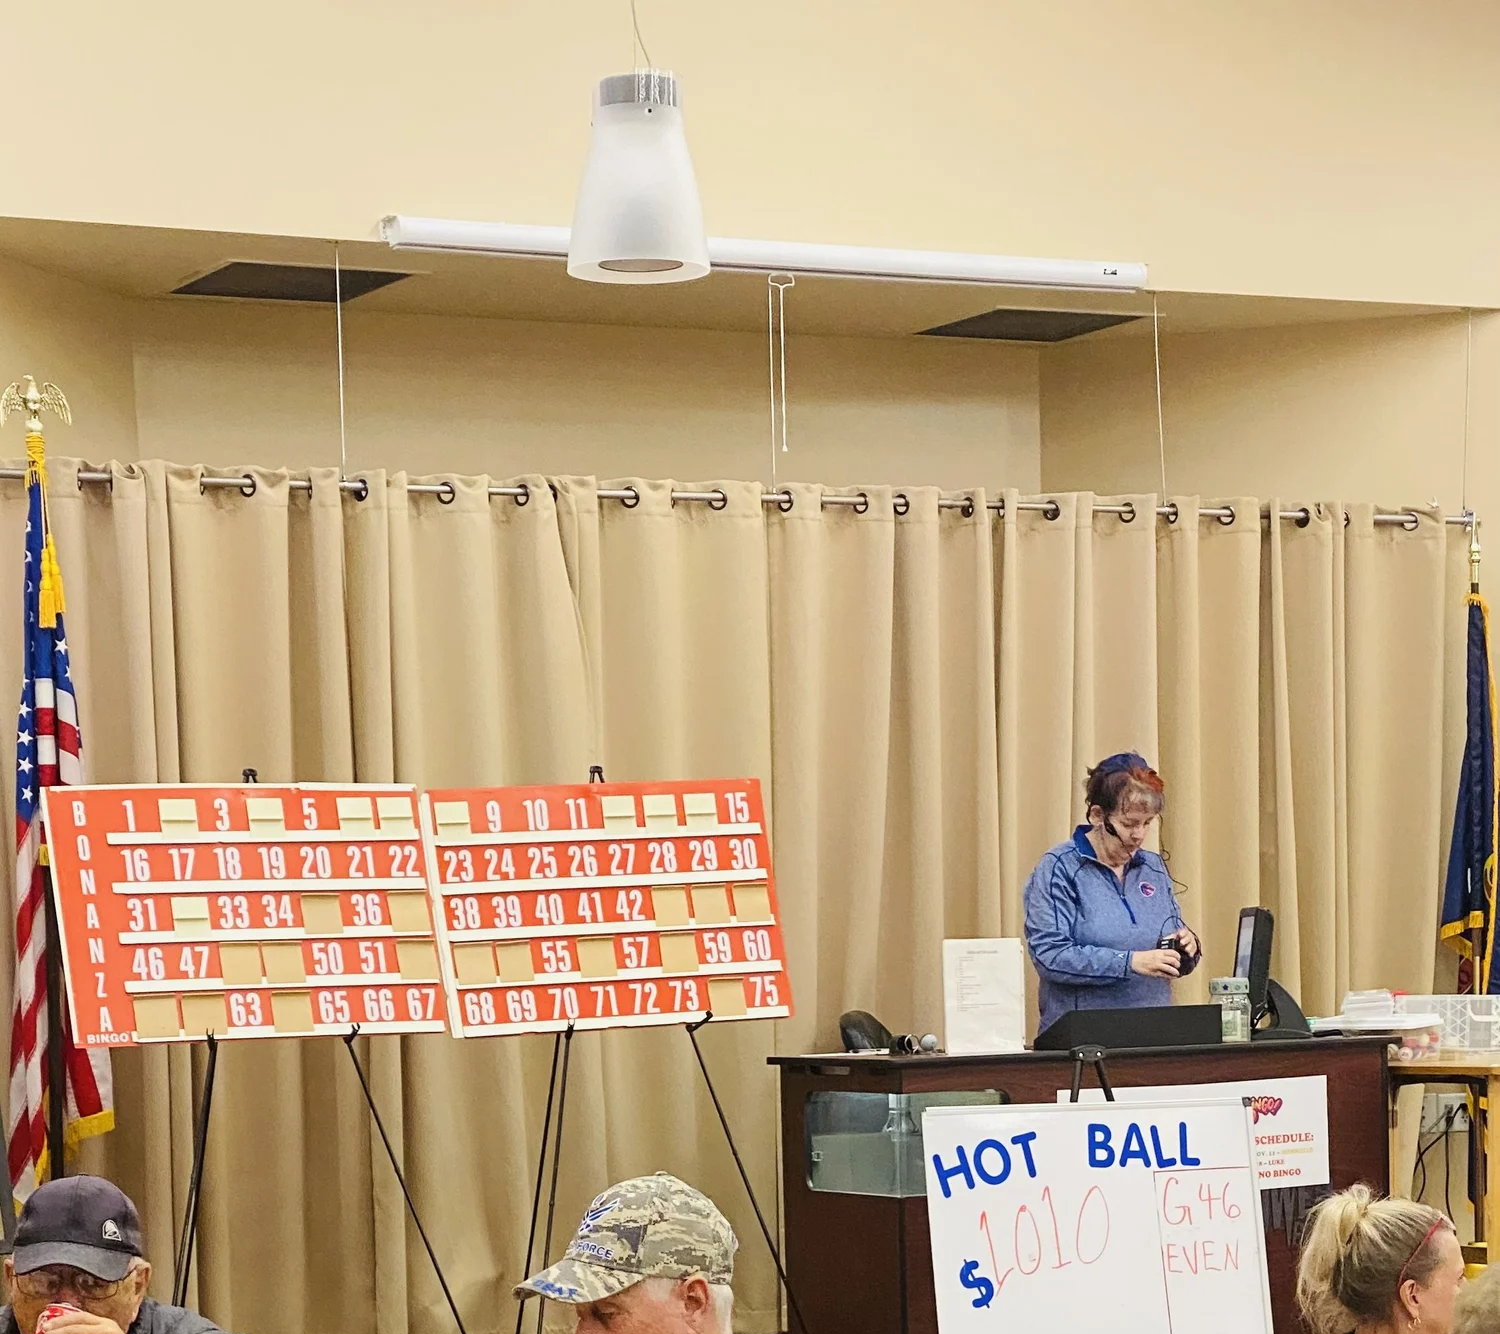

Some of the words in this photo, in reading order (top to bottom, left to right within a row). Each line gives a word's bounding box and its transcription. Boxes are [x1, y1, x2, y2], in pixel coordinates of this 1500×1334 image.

[122, 800, 137, 832] 1
[214, 798, 229, 831] 3
[302, 798, 317, 830] 5
[486, 801, 501, 832] 9
[523, 799, 548, 831] 10
[565, 798, 588, 829] 11
[725, 792, 749, 823] 15
[120, 849, 150, 881] 16
[168, 849, 195, 880] 17
[213, 848, 242, 879] 18
[258, 847, 286, 878] 19
[300, 846, 331, 878] 20
[347, 846, 375, 878] 21
[389, 846, 420, 877] 22
[444, 850, 474, 882] 23
[484, 849, 515, 880] 24
[528, 848, 557, 878] 25
[568, 845, 598, 876] 26
[608, 844, 635, 875] 27
[648, 842, 677, 872] 28
[689, 840, 718, 871] 29
[729, 839, 757, 869] 30
[127, 898, 156, 932] 31
[218, 896, 249, 929] 33
[262, 895, 293, 927] 34
[351, 894, 381, 926] 36
[450, 898, 481, 930] 38
[492, 896, 522, 928] 39
[535, 894, 564, 926] 40
[578, 892, 604, 923] 41
[616, 890, 645, 921] 42
[132, 948, 165, 980] 46
[179, 947, 209, 978] 47
[312, 943, 343, 974] 50
[360, 942, 386, 973] 51
[541, 941, 571, 972] 55
[622, 937, 648, 968] 57
[703, 932, 732, 963] 59
[743, 930, 771, 961] 60
[230, 993, 262, 1026] 63
[318, 991, 350, 1022] 65
[363, 990, 395, 1021] 66
[406, 988, 435, 1020] 67
[464, 992, 495, 1025] 68
[506, 990, 537, 1021] 69
[548, 988, 579, 1019] 70
[591, 986, 618, 1016] 71
[629, 983, 660, 1013] 72
[669, 980, 699, 1011] 73
[750, 976, 779, 1006] 75
[86, 1031, 130, 1044] BINGO
[1254, 1132, 1314, 1145] SCHEDULE:
[932, 1131, 1037, 1198] HOT
[1087, 1122, 1200, 1168] BALL
[1258, 1170, 1271, 1178] NO
[1273, 1168, 1301, 1177] BINGO
[576, 1241, 614, 1259] FORCE
[1167, 1240, 1239, 1274] EVEN
